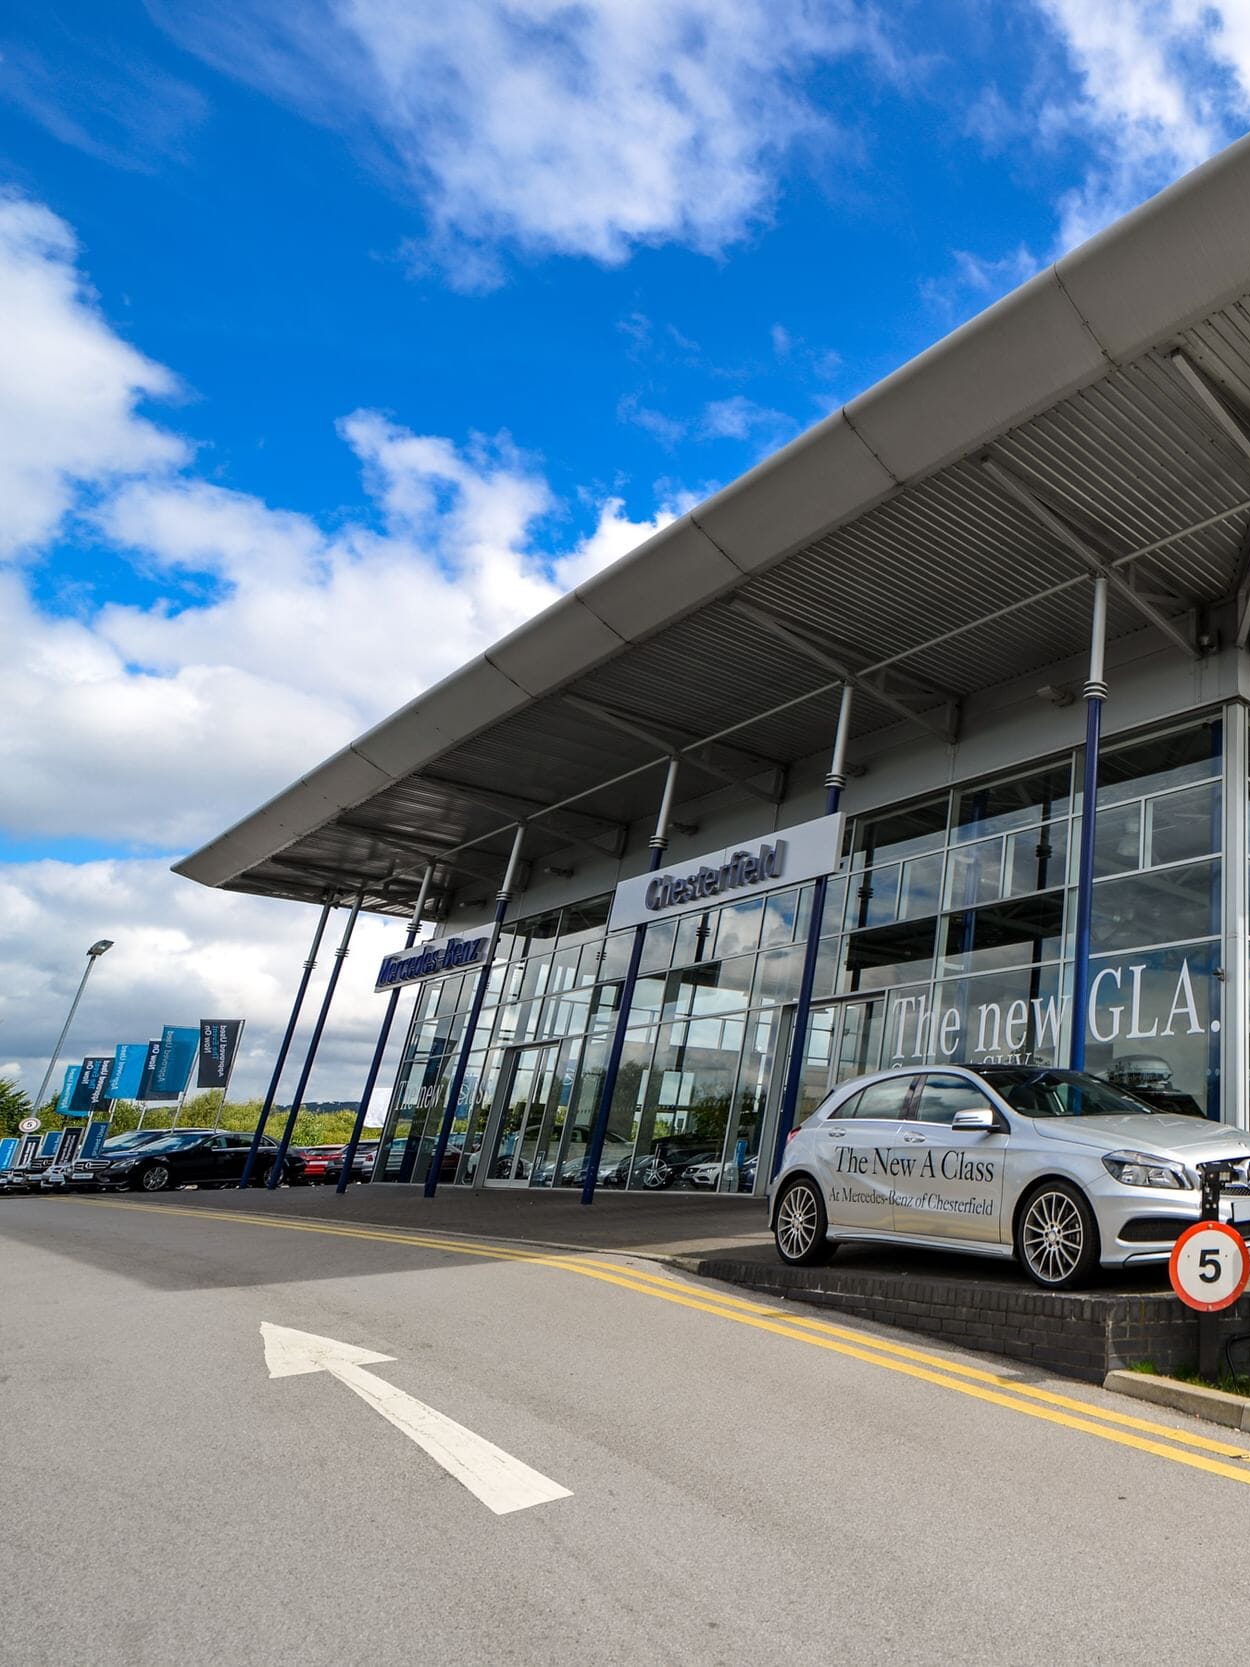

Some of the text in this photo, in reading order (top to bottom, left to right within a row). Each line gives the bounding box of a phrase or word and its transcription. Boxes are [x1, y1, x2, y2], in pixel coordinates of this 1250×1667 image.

[645, 839, 787, 910] Chesterfield
[376, 937, 490, 987] Mercedes-Benz
[892, 957, 1221, 1059] The new GLA.
[416, 1084, 445, 1109] new
[835, 1146, 994, 1183] The New A Class
[829, 1187, 993, 1216] At Mercedes-Benz of Chesterfield
[1199, 1248, 1222, 1284] 5
